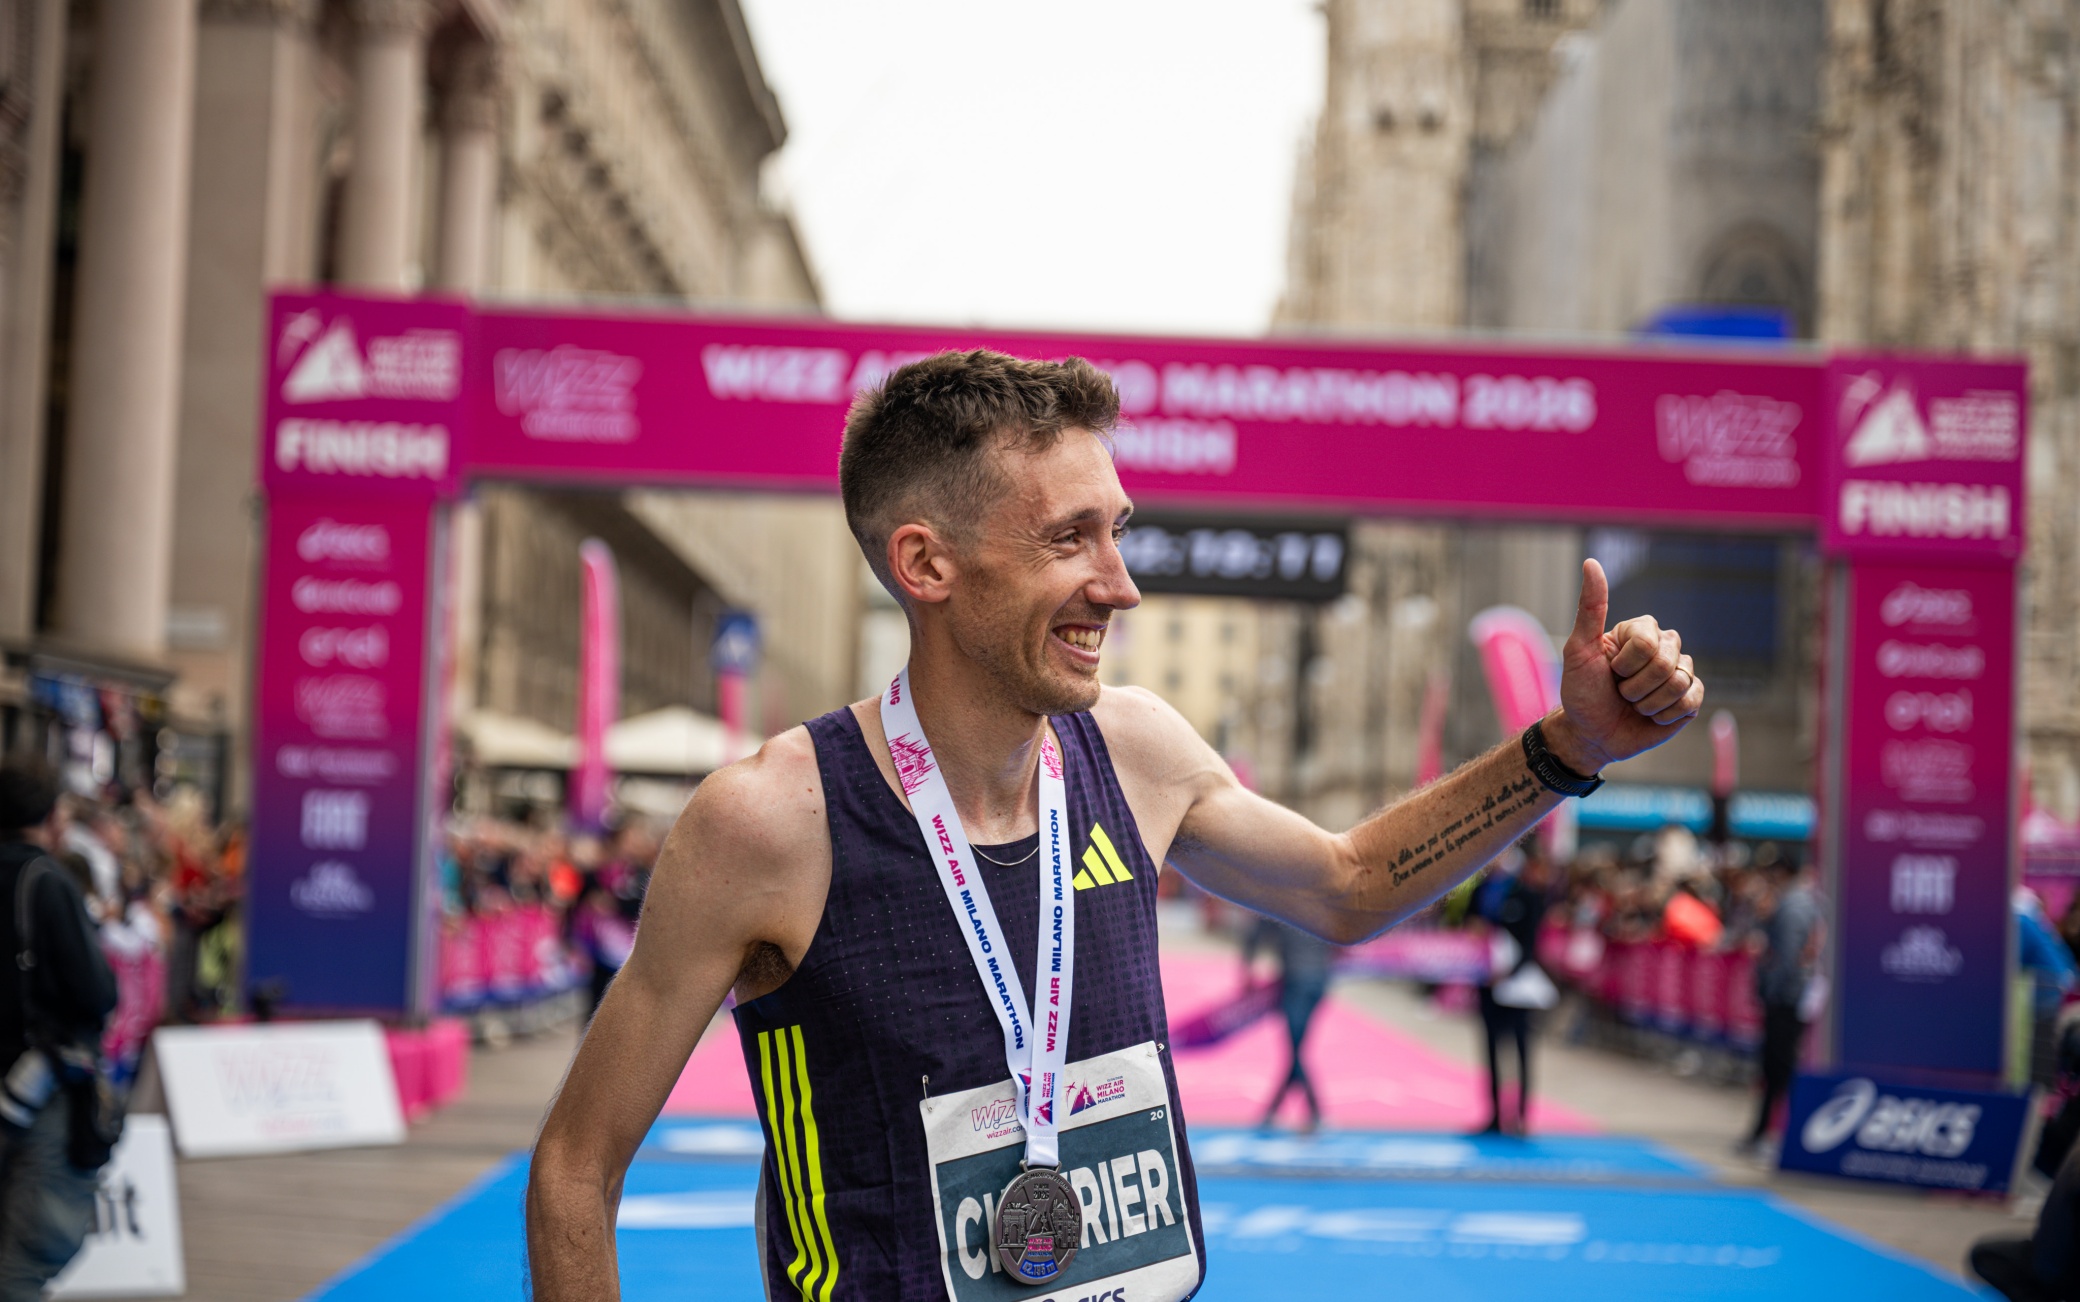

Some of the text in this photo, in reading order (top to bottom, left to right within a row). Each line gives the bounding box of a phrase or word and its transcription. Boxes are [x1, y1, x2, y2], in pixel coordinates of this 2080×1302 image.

[1165, 364, 1455, 424] MARATHON
[279, 421, 447, 476] FINISH
[1843, 482, 2007, 536] FINISH
[889, 673, 901, 706] LING
[931, 814, 1024, 1050] WIZZ AIR MILANO MARATHON
[1046, 809, 1063, 1052] WIZZ AIR MILANO MARATHON
[1096, 1083, 1112, 1091] WIZZ
[1114, 1079, 1124, 1087] AIR
[1097, 1086, 1125, 1098] MILANO
[1097, 1093, 1125, 1104] MARATHON
[1150, 1110, 1164, 1121] 20
